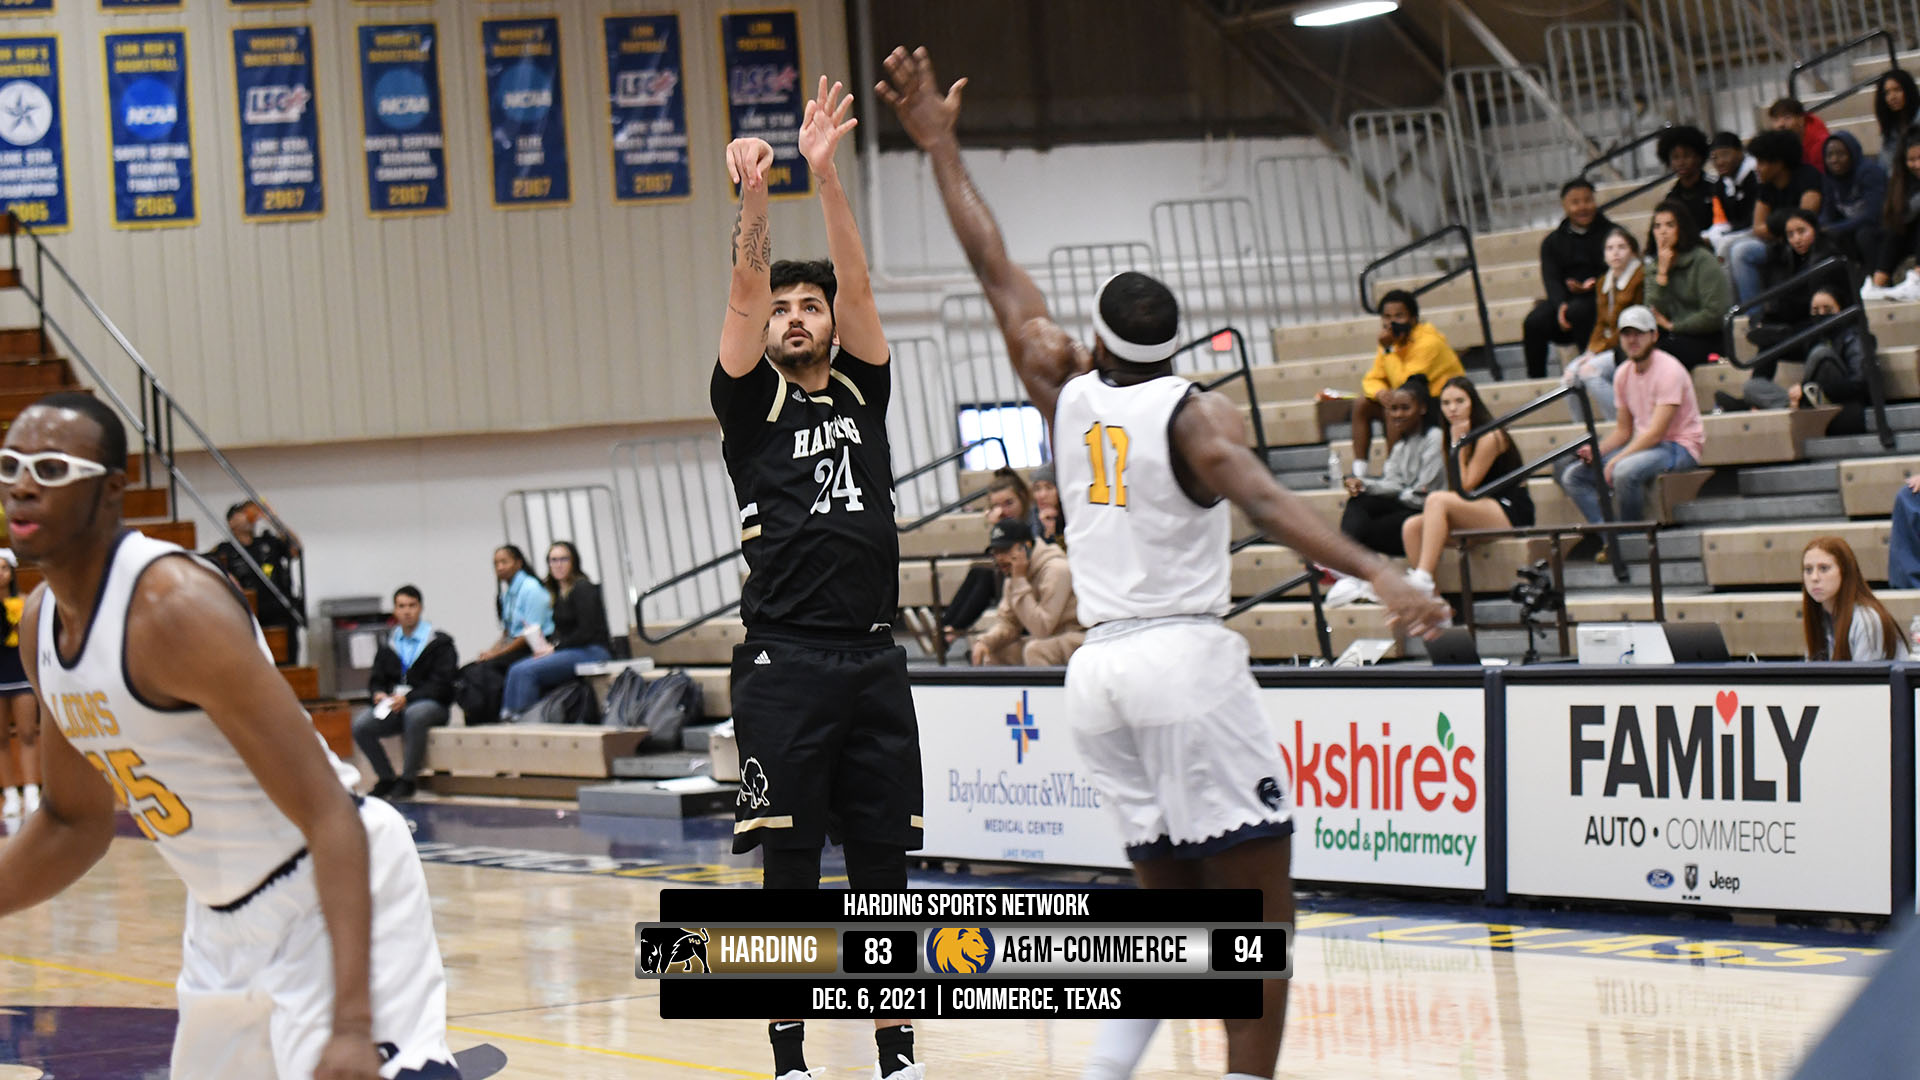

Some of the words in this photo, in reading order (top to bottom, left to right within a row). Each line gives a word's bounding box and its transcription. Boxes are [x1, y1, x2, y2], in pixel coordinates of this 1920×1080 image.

[378, 96, 430, 116] NCAA
[502, 89, 552, 110] NCAA
[125, 104, 178, 126] NCAA
[389, 184, 429, 206] 2007
[809, 445, 865, 515] 24
[984, 819, 1024, 834] MEDICAL
[1028, 821, 1064, 836] CENTER
[1585, 815, 1646, 848] AUTO
[1666, 817, 1797, 855] COMMERCE
[1709, 869, 1740, 894] Jeep
[1368, 922, 1891, 968] CLASS
